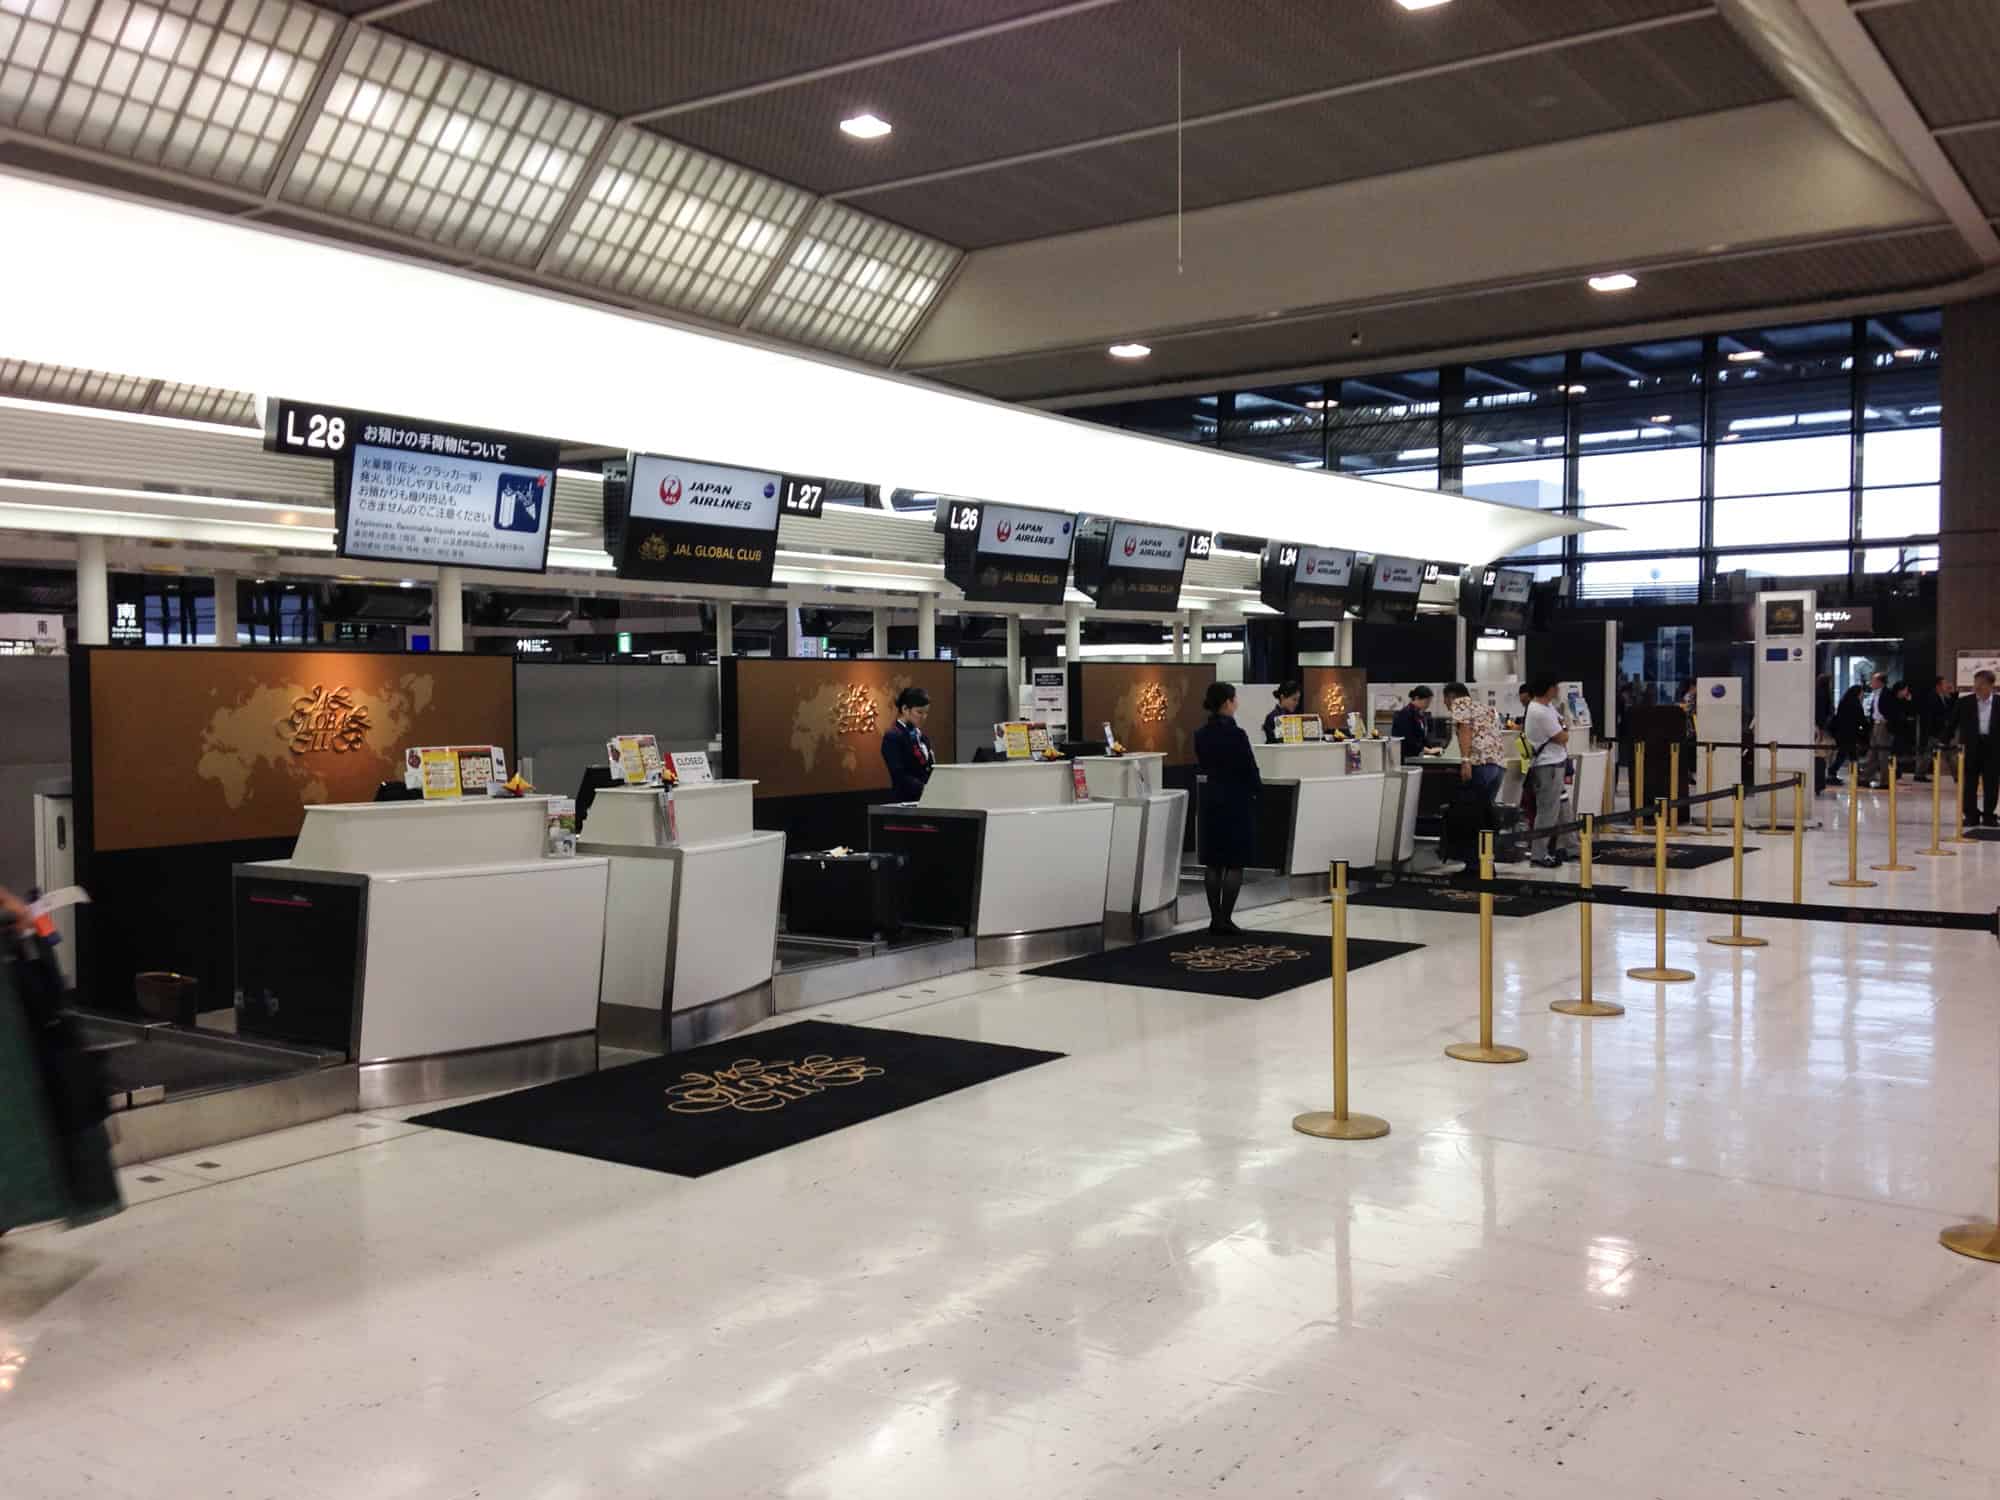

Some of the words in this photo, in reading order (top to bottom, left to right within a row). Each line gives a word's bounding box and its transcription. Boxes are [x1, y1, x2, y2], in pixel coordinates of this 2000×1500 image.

[286, 411, 345, 449] L28
[363, 425, 507, 460] お預けの手荷物について
[689, 481, 732, 495] JAPAN
[787, 482, 822, 511] L27
[689, 495, 752, 512] AIRLINES
[950, 506, 979, 531] L26
[1015, 522, 1043, 533] JAPAN
[1015, 533, 1055, 545] AIRLINES
[673, 543, 692, 556] JAL
[694, 544, 735, 560] GLOBAL
[736, 548, 762, 561] CLUB
